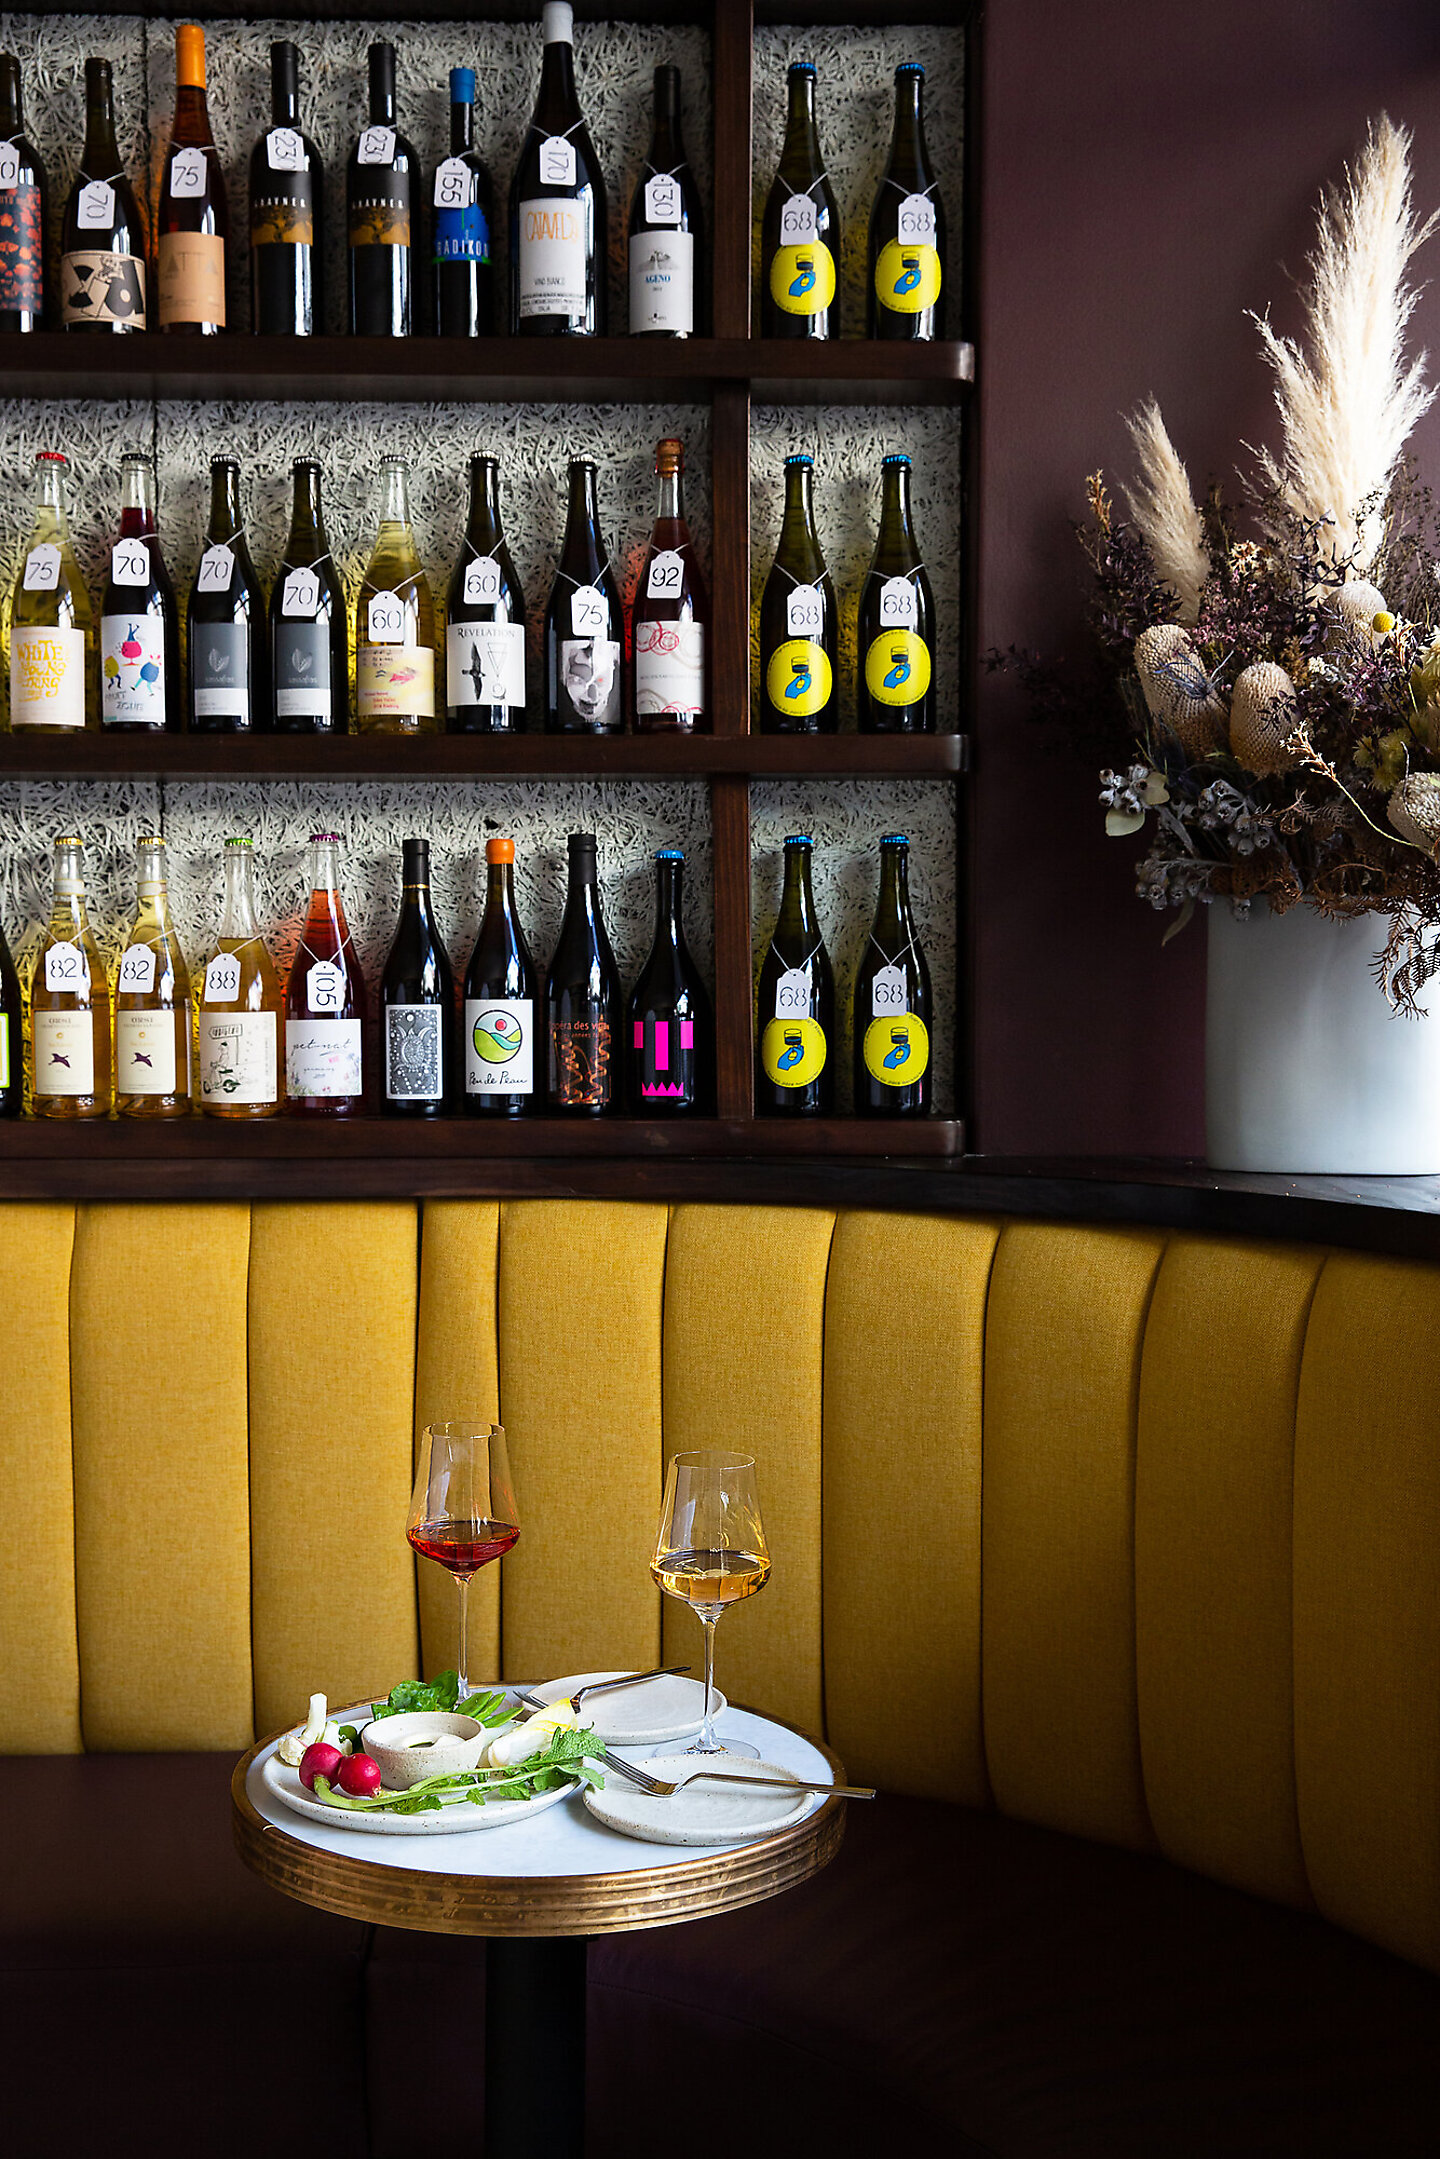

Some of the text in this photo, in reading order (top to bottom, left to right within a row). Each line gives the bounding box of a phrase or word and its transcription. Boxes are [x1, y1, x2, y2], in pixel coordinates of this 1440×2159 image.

[273, 135, 297, 170] 230
[364, 133, 388, 164] 230
[174, 165, 199, 188] 75
[547, 151, 569, 181] 170
[441, 171, 464, 203] 155
[86, 194, 109, 219] 70
[653, 183, 673, 216] 130
[784, 211, 812, 232] 68
[901, 212, 930, 232] 68
[28, 562, 53, 581] 75
[117, 556, 146, 575] 70
[203, 561, 229, 580] 70
[467, 575, 497, 594] 60
[652, 567, 680, 588] 92
[286, 586, 313, 606] 70
[884, 594, 912, 614] 68
[372, 609, 402, 630] 60
[578, 604, 603, 625] 75
[791, 605, 820, 625] 68
[50, 957, 78, 978] 82
[123, 960, 150, 980] 82
[209, 970, 236, 990] 88
[316, 971, 337, 1006] 105
[780, 986, 807, 1007] 68
[875, 982, 903, 1003] 68
